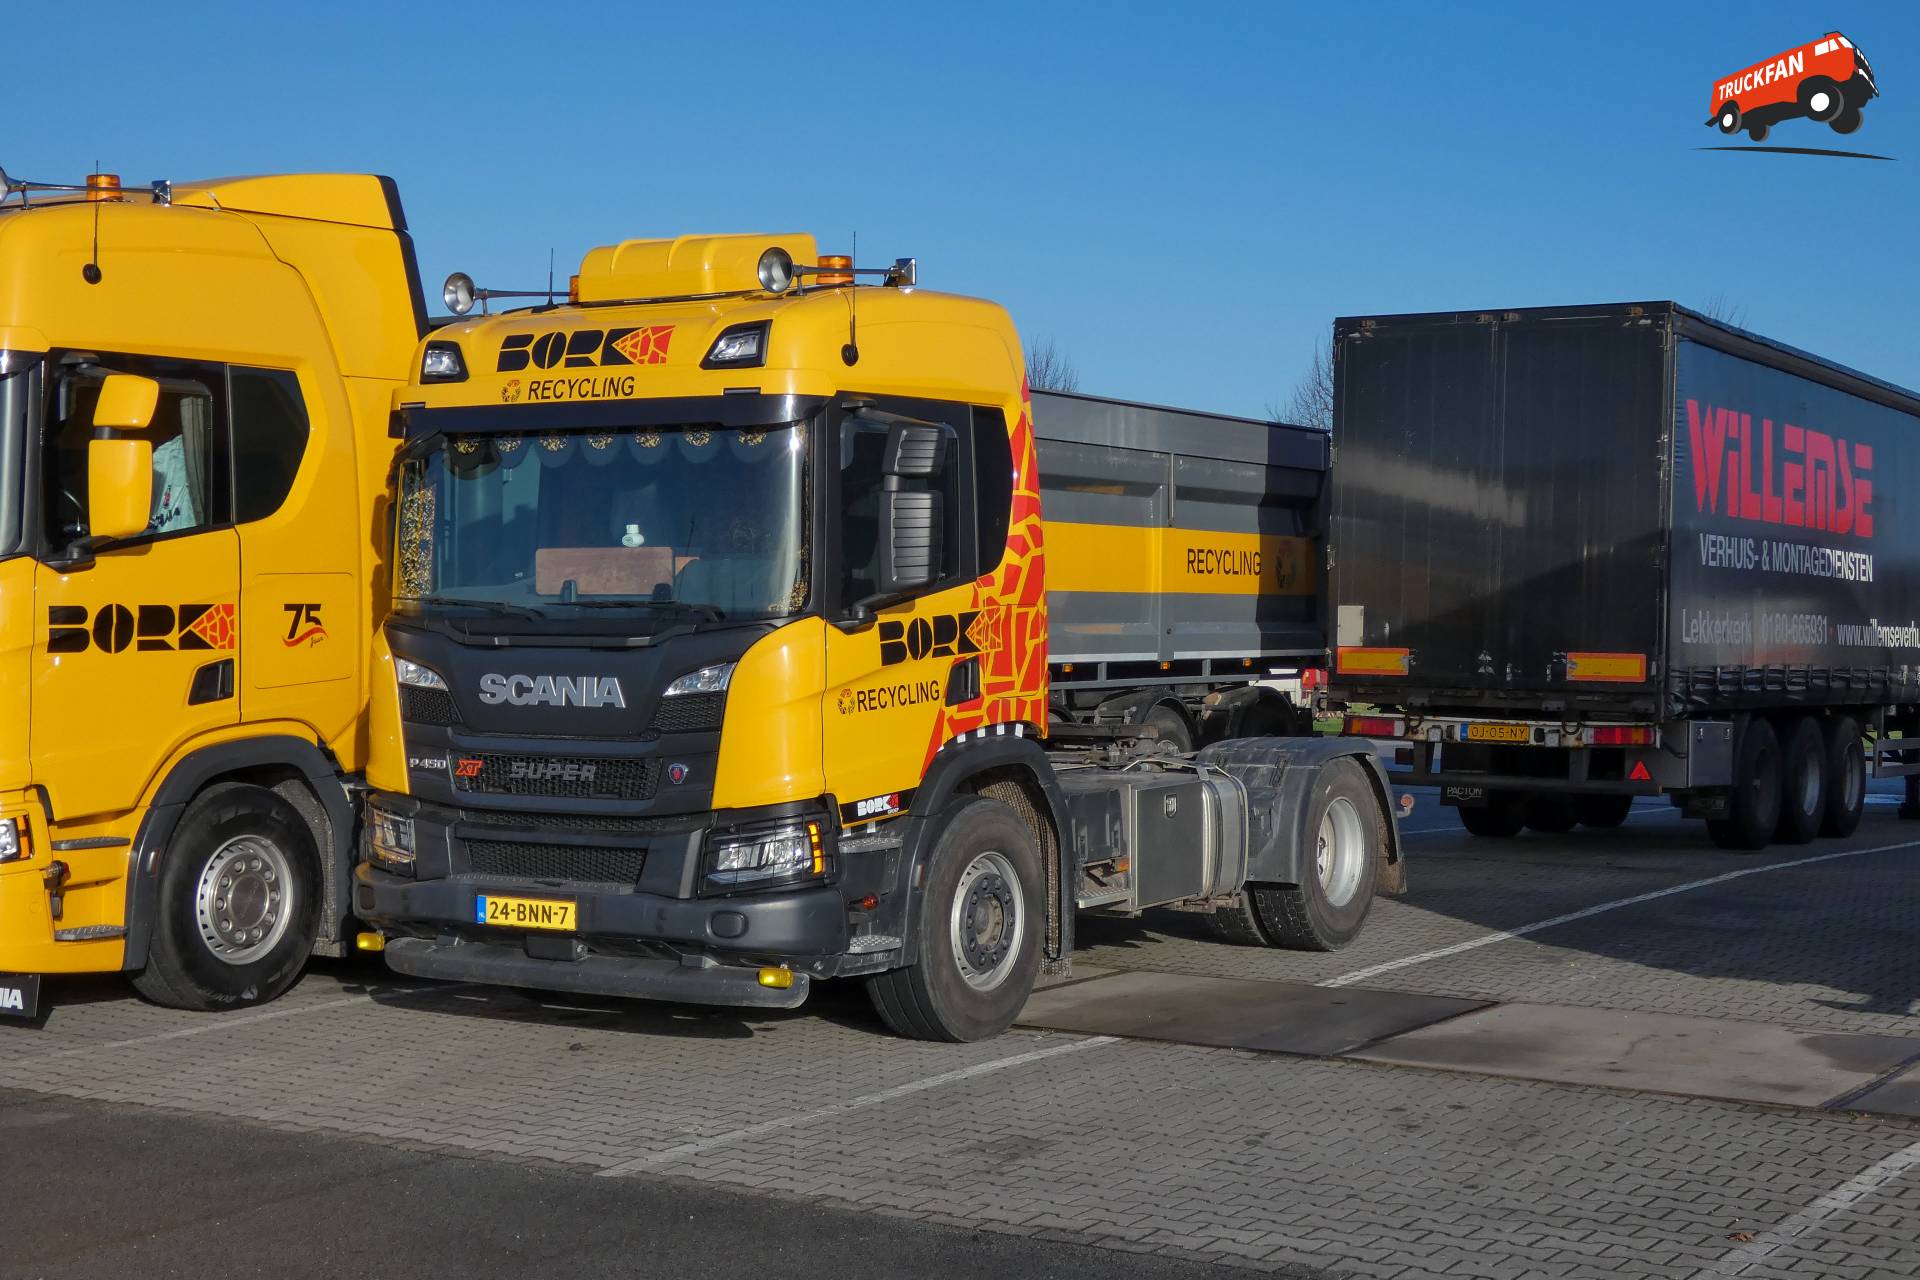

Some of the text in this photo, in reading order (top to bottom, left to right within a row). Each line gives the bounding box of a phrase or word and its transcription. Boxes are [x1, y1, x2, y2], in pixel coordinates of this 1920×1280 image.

[496, 326, 645, 373] BORK
[528, 376, 635, 401] RECYCLING
[1187, 548, 1262, 576] RECYCLING
[1699, 532, 1873, 582] VERHUIS- & MONTAGEDIENSTEN
[47, 603, 216, 654] BORK
[283, 603, 322, 640] 75
[878, 610, 982, 667] BORK
[1682, 608, 1751, 644] Lekkerkerk
[478, 673, 627, 709] SCANIA
[857, 680, 940, 713] RECYCLING
[456, 759, 484, 777] XT
[510, 761, 597, 782] SUPER
[857, 794, 893, 817] BORK
[489, 901, 569, 925] 24-BNN-7
